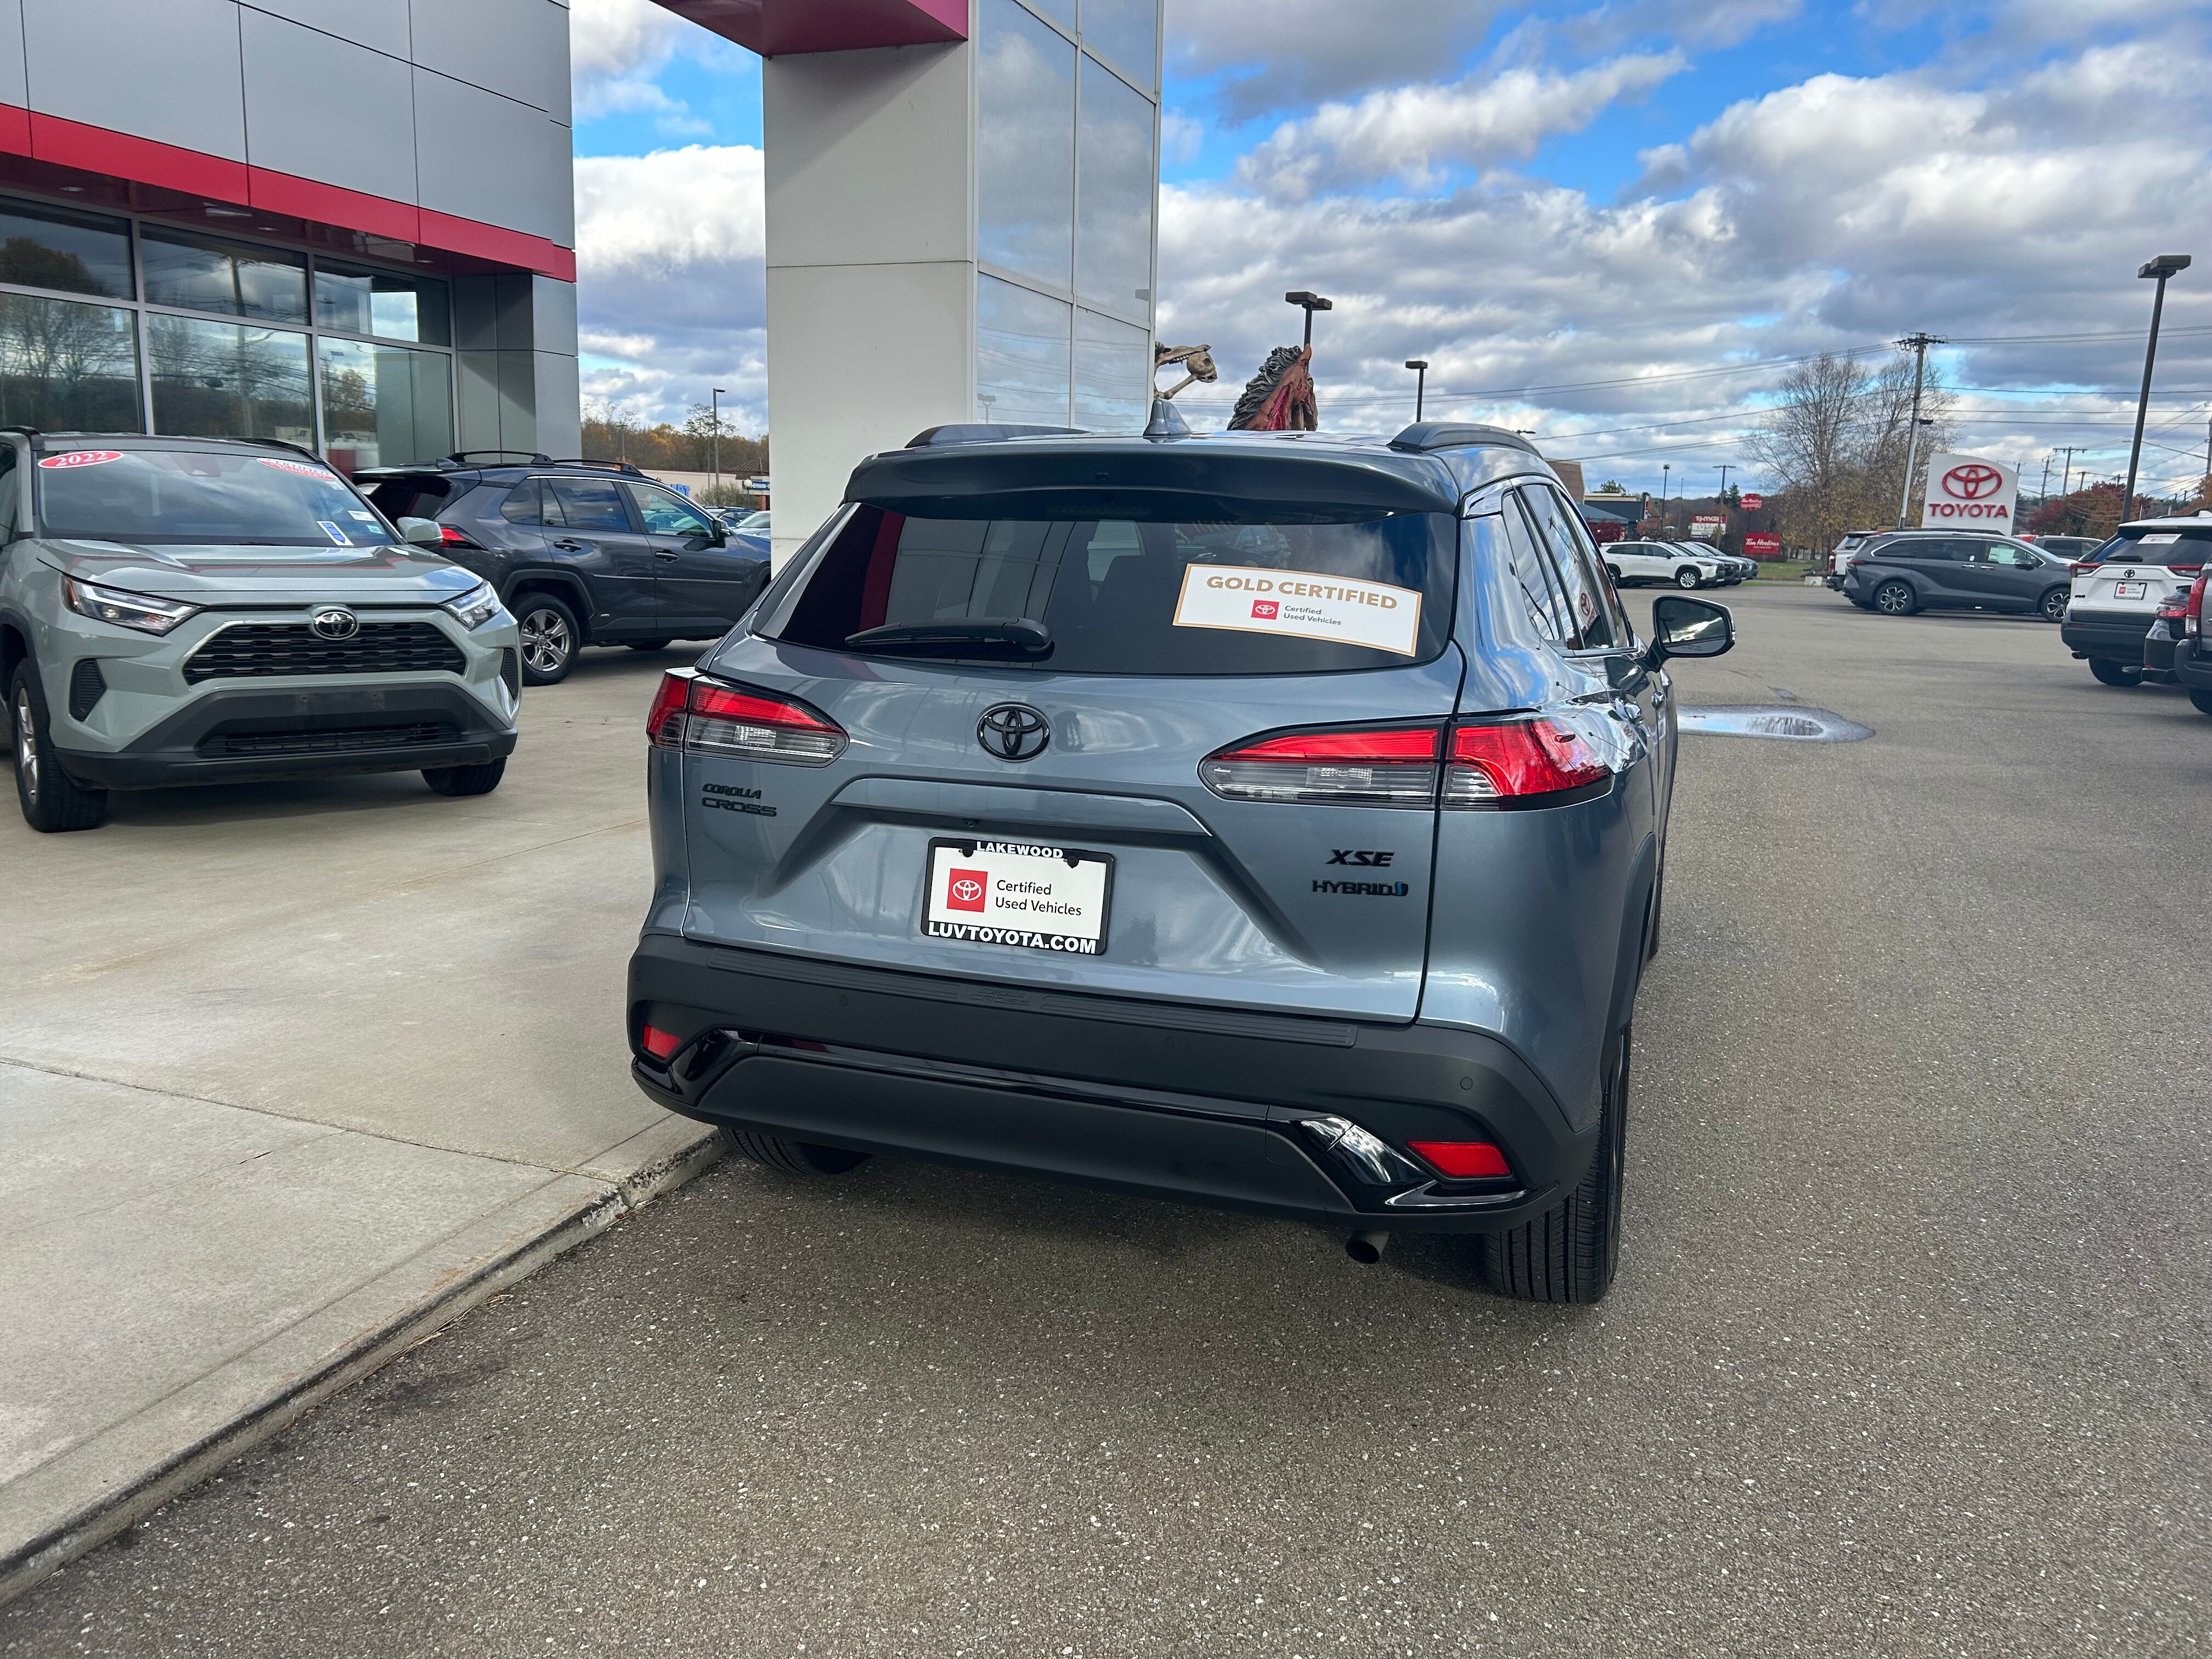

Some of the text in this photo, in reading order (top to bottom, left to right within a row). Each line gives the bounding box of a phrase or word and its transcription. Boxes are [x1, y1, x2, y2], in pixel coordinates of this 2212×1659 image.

[55, 452, 106, 466] 2022
[1928, 503, 2008, 518] TOYOTA
[1206, 576, 1397, 610] GOLD CERTIFIED
[1285, 605, 1322, 614] Certified
[1307, 615, 1342, 625] Vehicles
[702, 783, 761, 799] COROLLA
[702, 797, 777, 817] CROSS
[977, 842, 1063, 858] LAKEWOOD
[1325, 849, 1395, 867] XSE
[997, 879, 1052, 895] Certified
[1312, 879, 1393, 896] HYBRID
[996, 896, 1082, 916] Used Vehicles
[928, 921, 1096, 954] LUVTOYOTA.COM
[970, 994, 1030, 1007] CROSS
